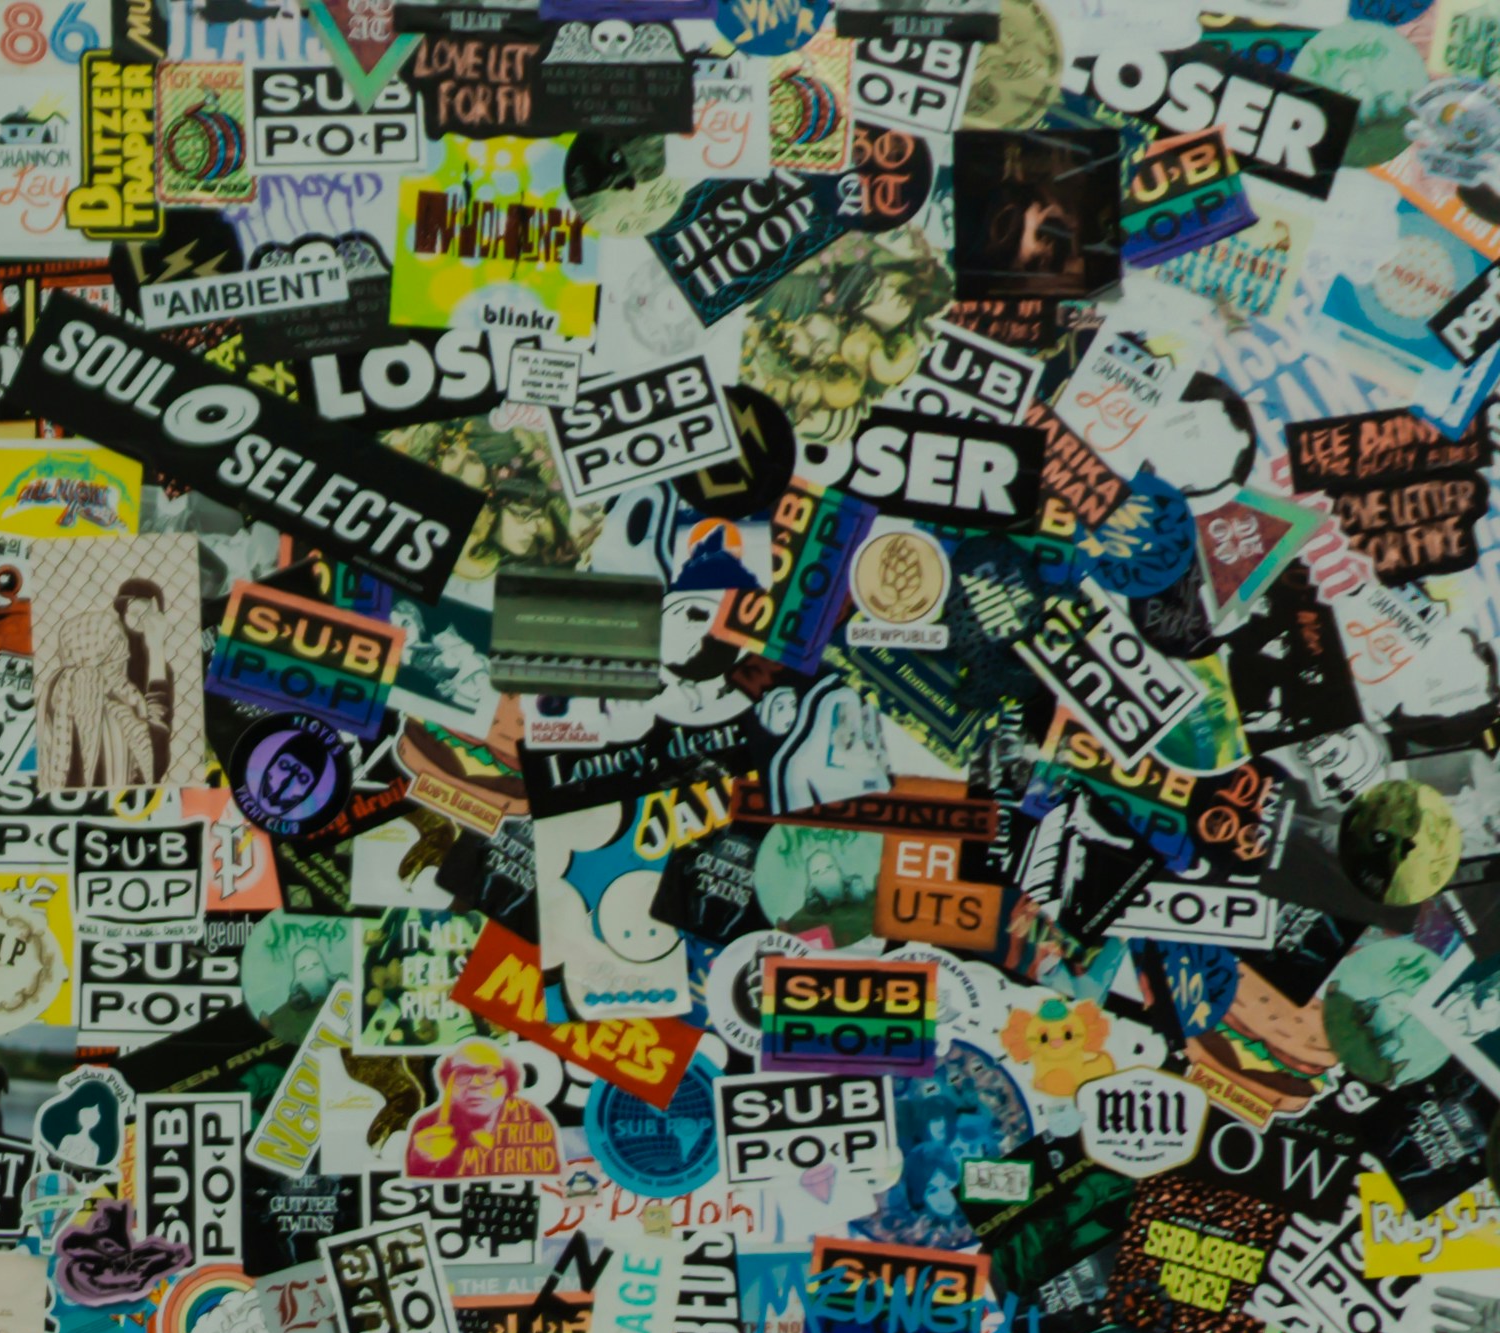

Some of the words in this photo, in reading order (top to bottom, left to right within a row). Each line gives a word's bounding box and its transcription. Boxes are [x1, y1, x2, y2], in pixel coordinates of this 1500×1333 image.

[151, 267, 341, 318] "AMBIENT"
[44, 320, 172, 415] SOUL
[220, 435, 452, 573] SELECTS
[850, 624, 945, 647] BREWPUBLIC
